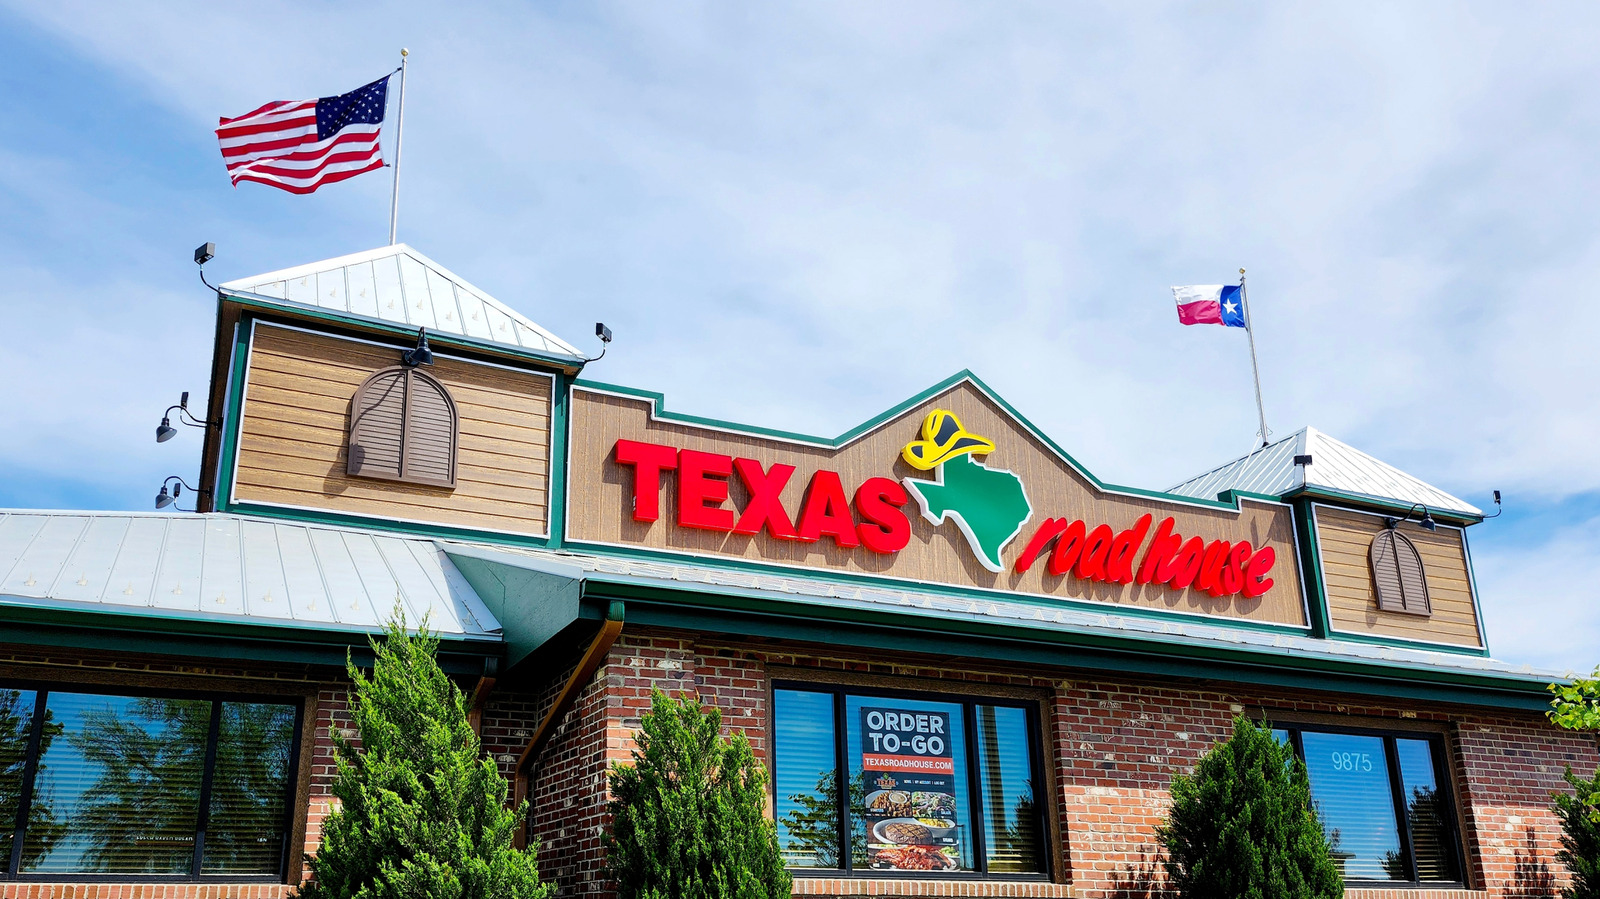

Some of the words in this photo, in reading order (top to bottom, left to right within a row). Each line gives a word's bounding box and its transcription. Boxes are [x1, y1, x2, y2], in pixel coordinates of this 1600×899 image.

[615, 438, 911, 554] TEXAS
[866, 711, 945, 734] ORDER
[868, 732, 945, 755] TO-GO
[865, 757, 952, 770] TEXASROADHOUSE.COM
[1331, 751, 1372, 772] 9875
